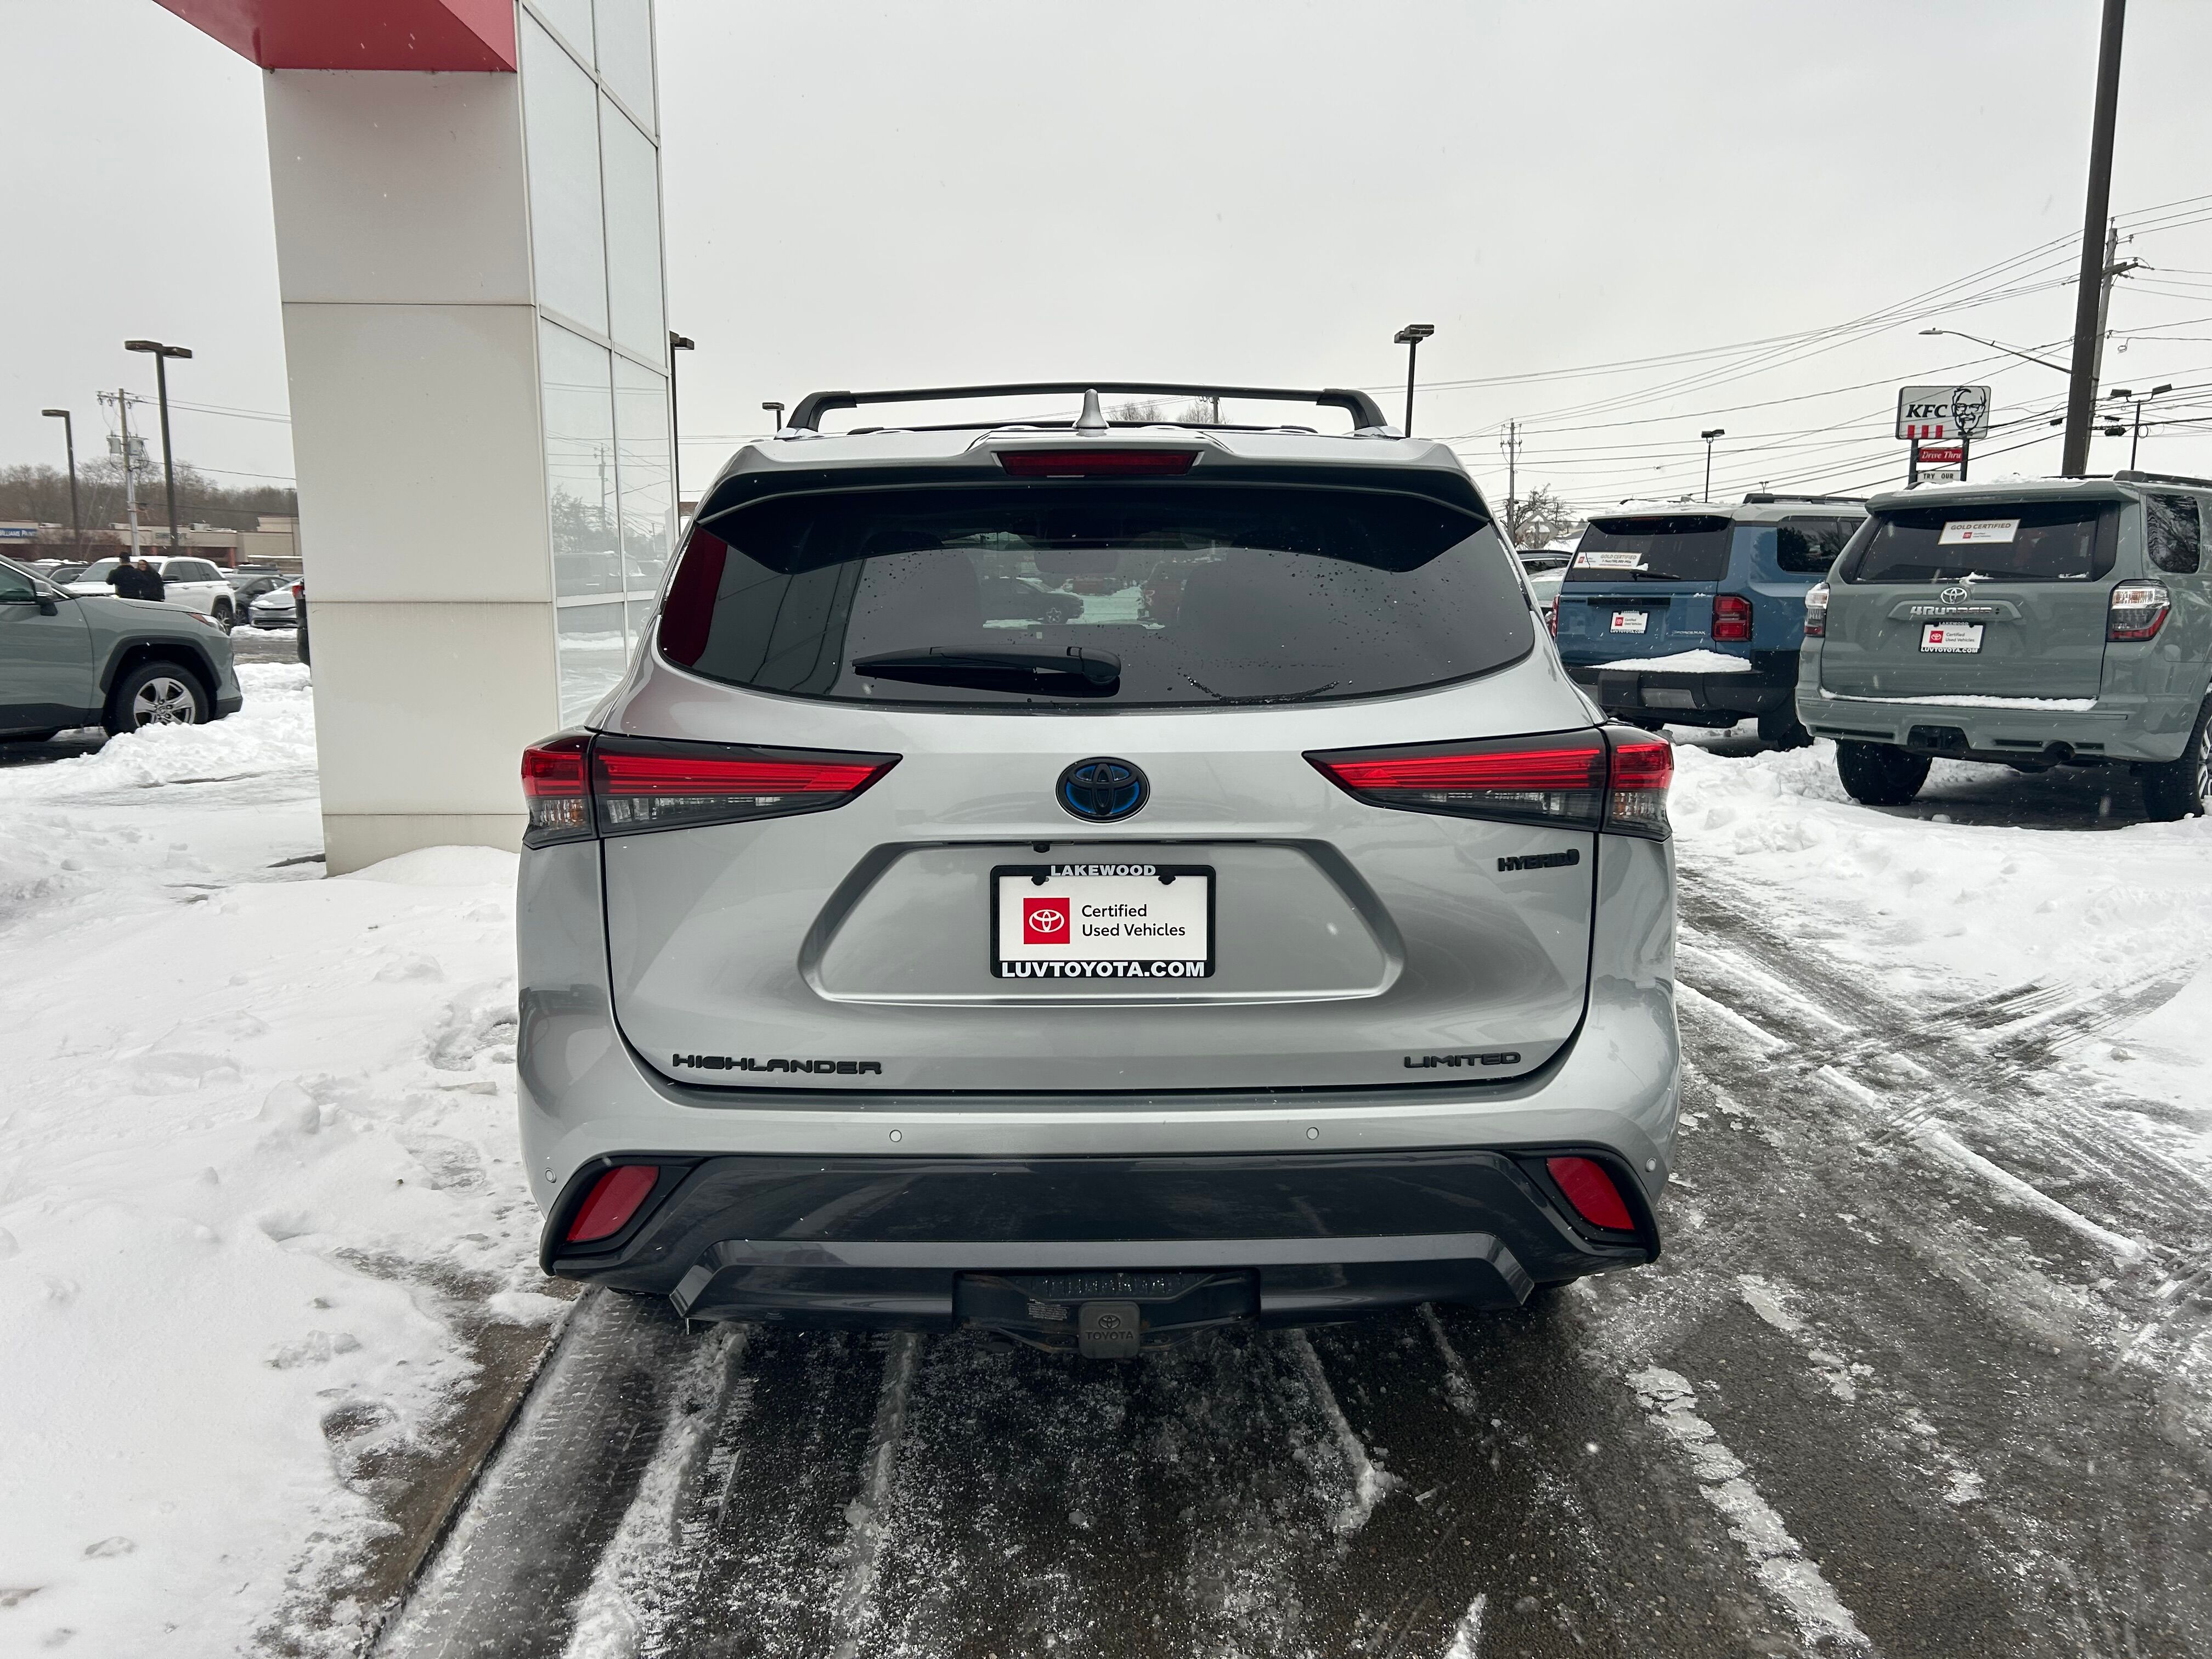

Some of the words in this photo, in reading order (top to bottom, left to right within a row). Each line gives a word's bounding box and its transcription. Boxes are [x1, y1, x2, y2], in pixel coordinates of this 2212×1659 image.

[1906, 404, 1948, 418] KFC
[1497, 851, 1571, 872] HYBRID
[1051, 865, 1156, 877] LAKEWOOD
[1081, 905, 1147, 917] Certified
[1082, 924, 1120, 936] Used
[1124, 923, 1186, 936] Vehicles
[1002, 962, 1205, 978] LUVTOYOTA.COM
[672, 1053, 882, 1075] HIGHLANDER
[1404, 1051, 1521, 1069] LIMITED
[1085, 1330, 1134, 1340] TOYOTA
